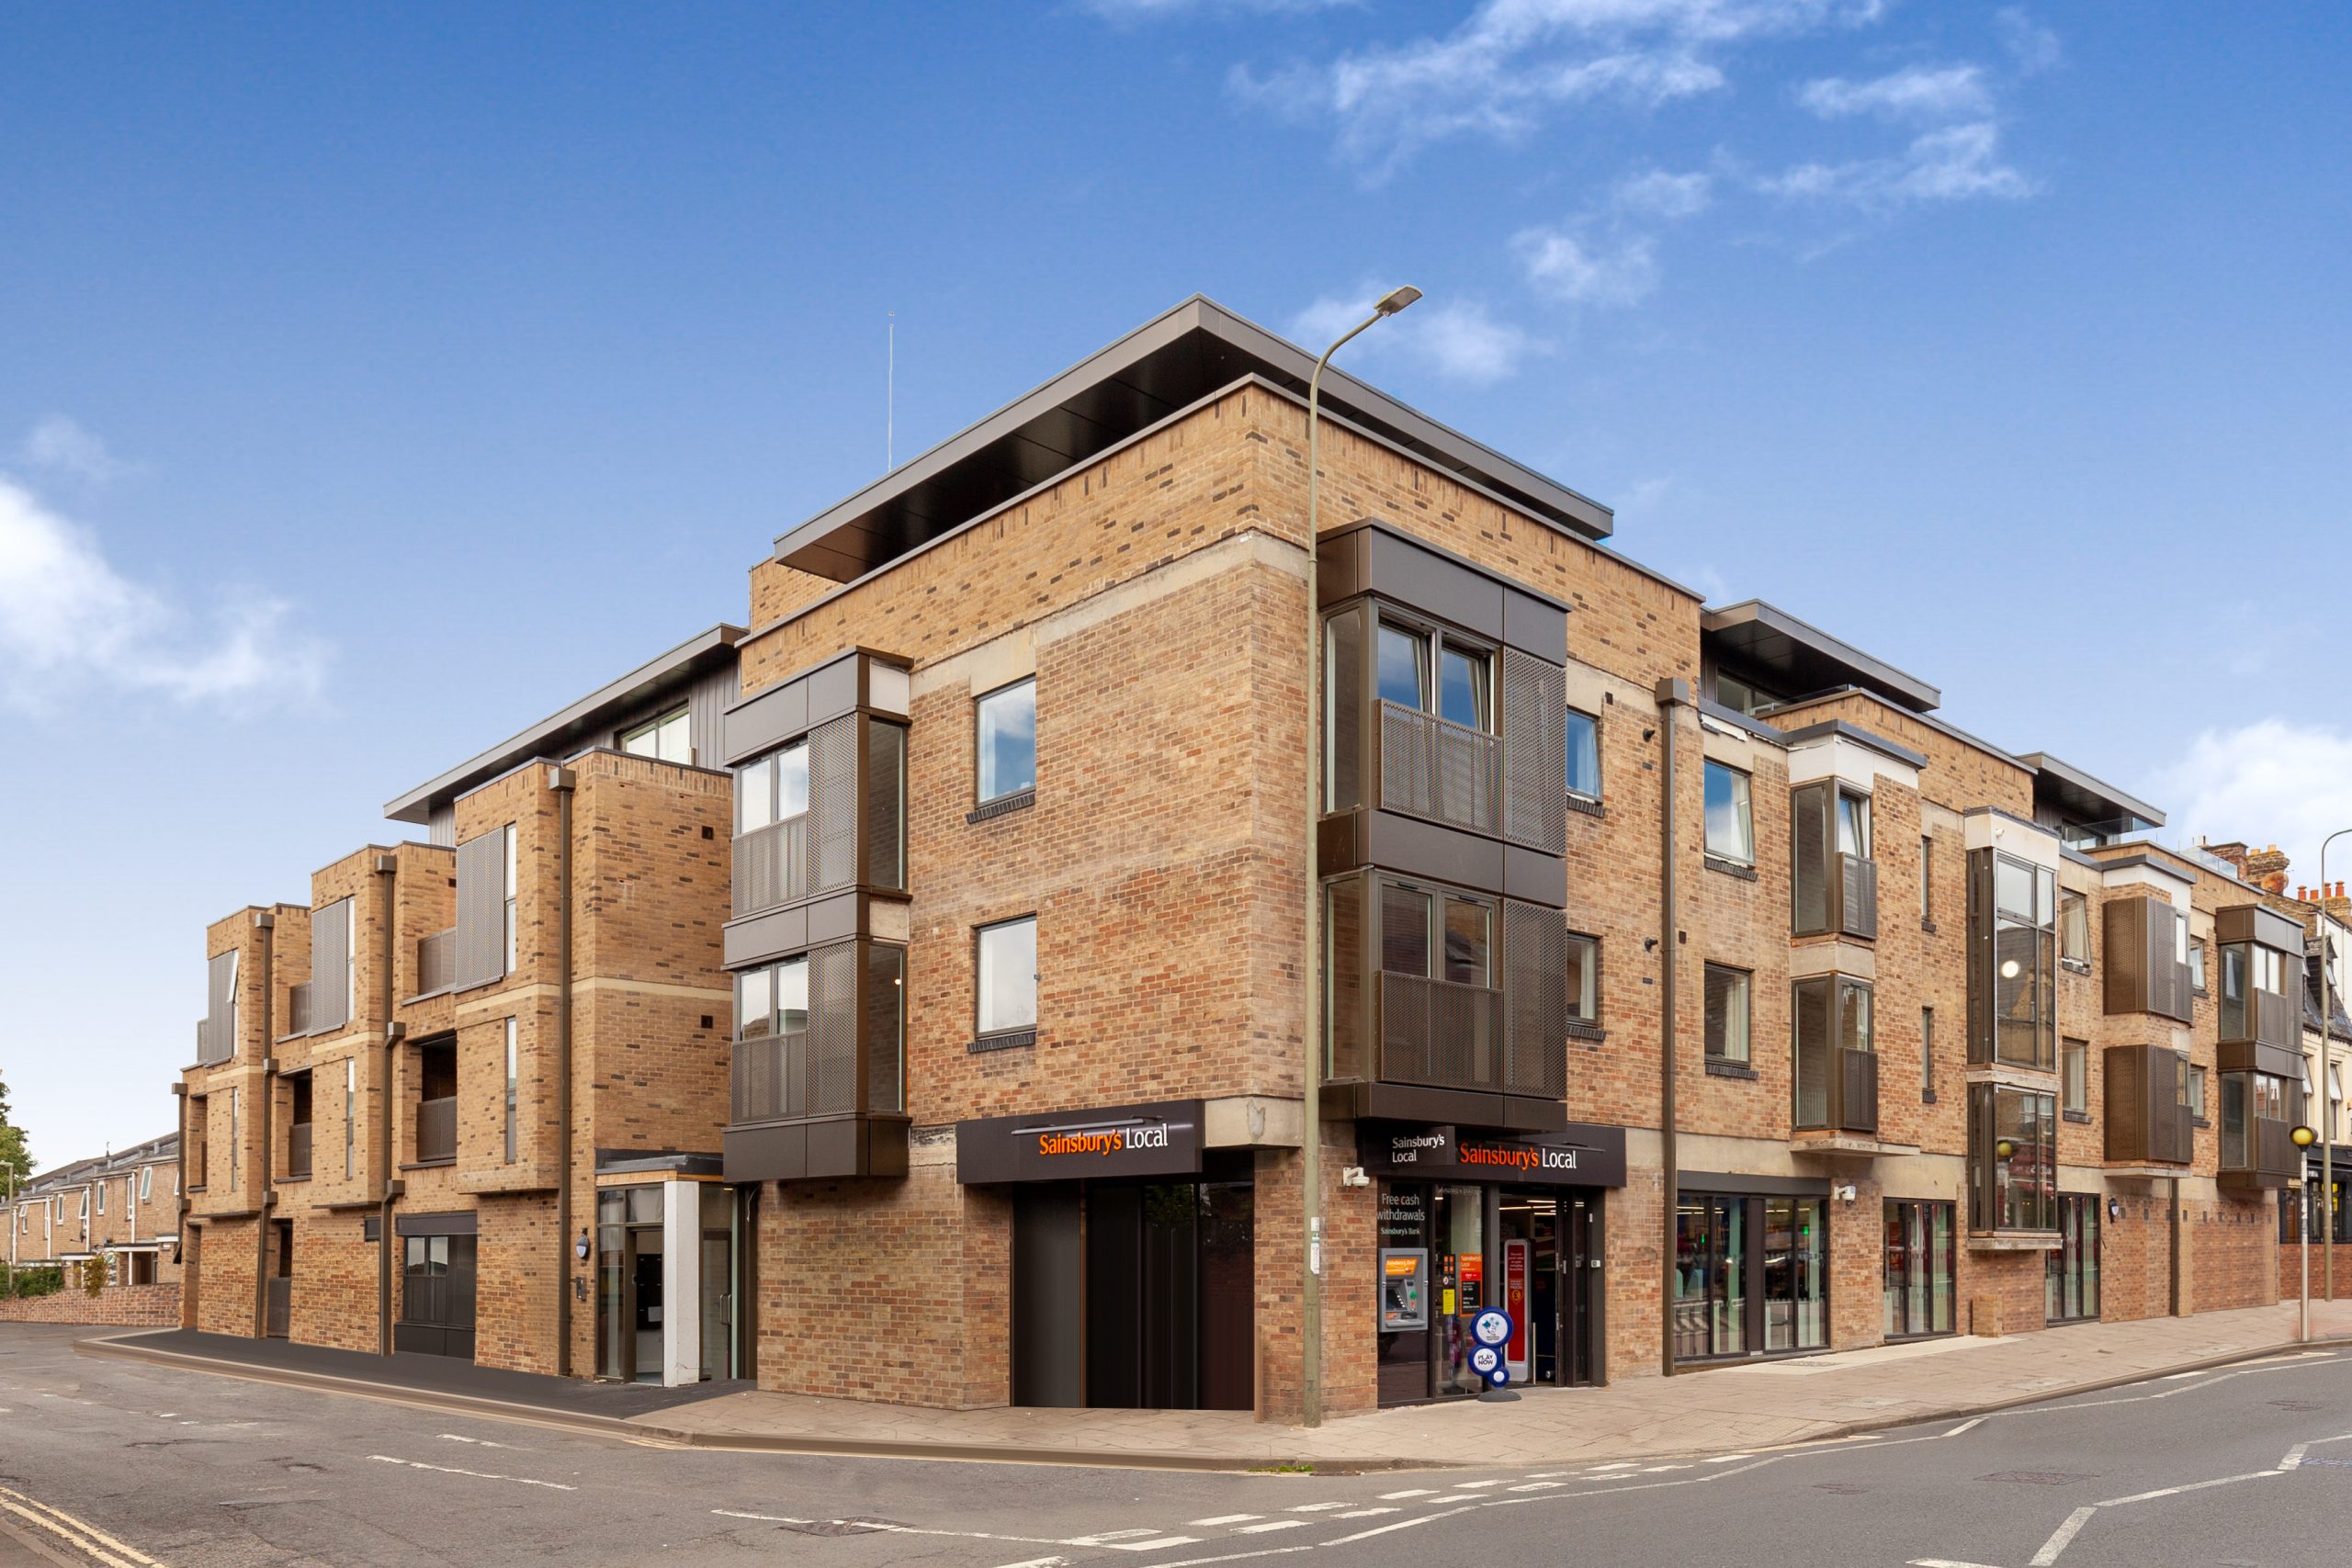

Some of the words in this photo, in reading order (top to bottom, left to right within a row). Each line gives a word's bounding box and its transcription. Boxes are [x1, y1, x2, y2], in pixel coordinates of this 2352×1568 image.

[1039, 1128, 1123, 1156] Sainsbury's
[1125, 1122, 1169, 1149] Local
[1392, 1134, 1445, 1149] Sainsbury's
[1392, 1149, 1417, 1163] Local
[1460, 1142, 1539, 1171] Sainsbury's
[1542, 1147, 1577, 1169] Local
[1381, 1193, 1399, 1205] Free
[1400, 1194, 1419, 1206] cash
[1377, 1209, 1426, 1221] withdrawals
